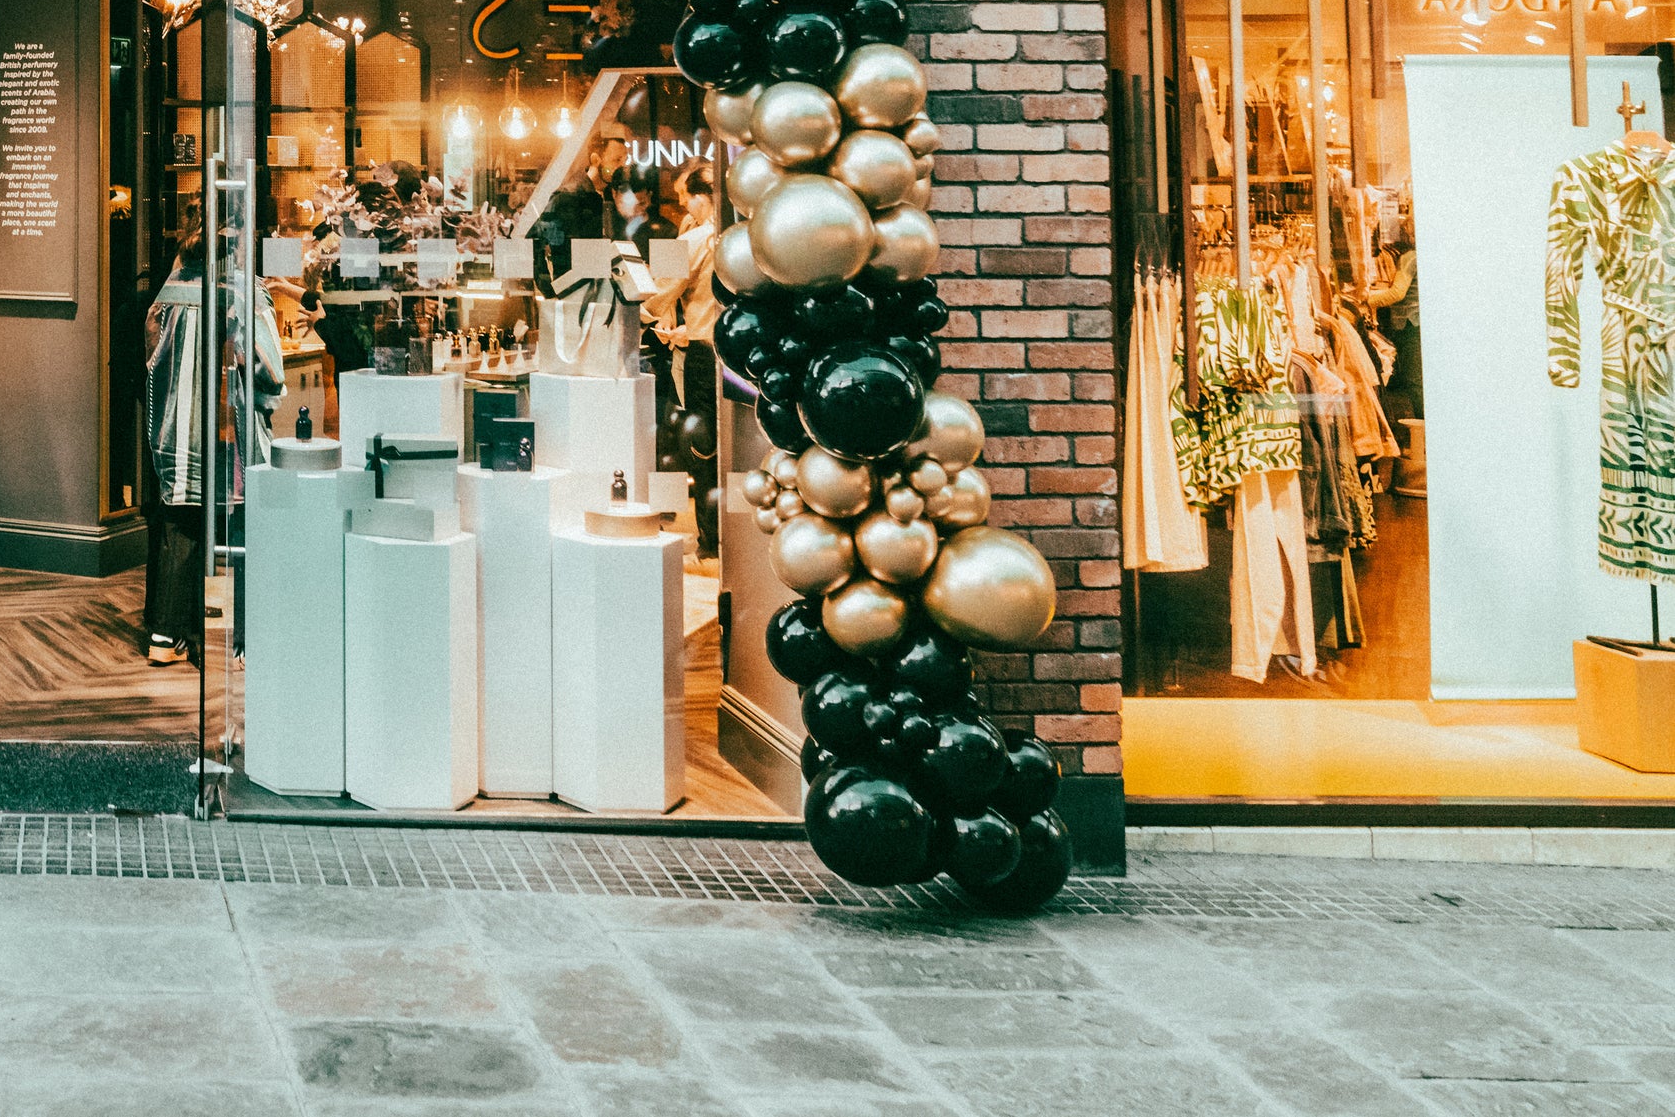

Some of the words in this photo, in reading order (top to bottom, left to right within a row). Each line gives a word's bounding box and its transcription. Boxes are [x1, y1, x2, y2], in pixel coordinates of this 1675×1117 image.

[3, 51, 54, 60] family-founded
[22, 61, 58, 69] perfumery
[3, 71, 31, 79] inspired
[32, 89, 56, 97] Arabia,
[10, 108, 26, 116] path
[2, 117, 34, 125] fragrance
[0, 172, 31, 180] fragrance
[20, 191, 52, 199] enchants,
[0, 200, 24, 208] making
[1, 219, 22, 227] place,
[26, 228, 43, 236] time.
